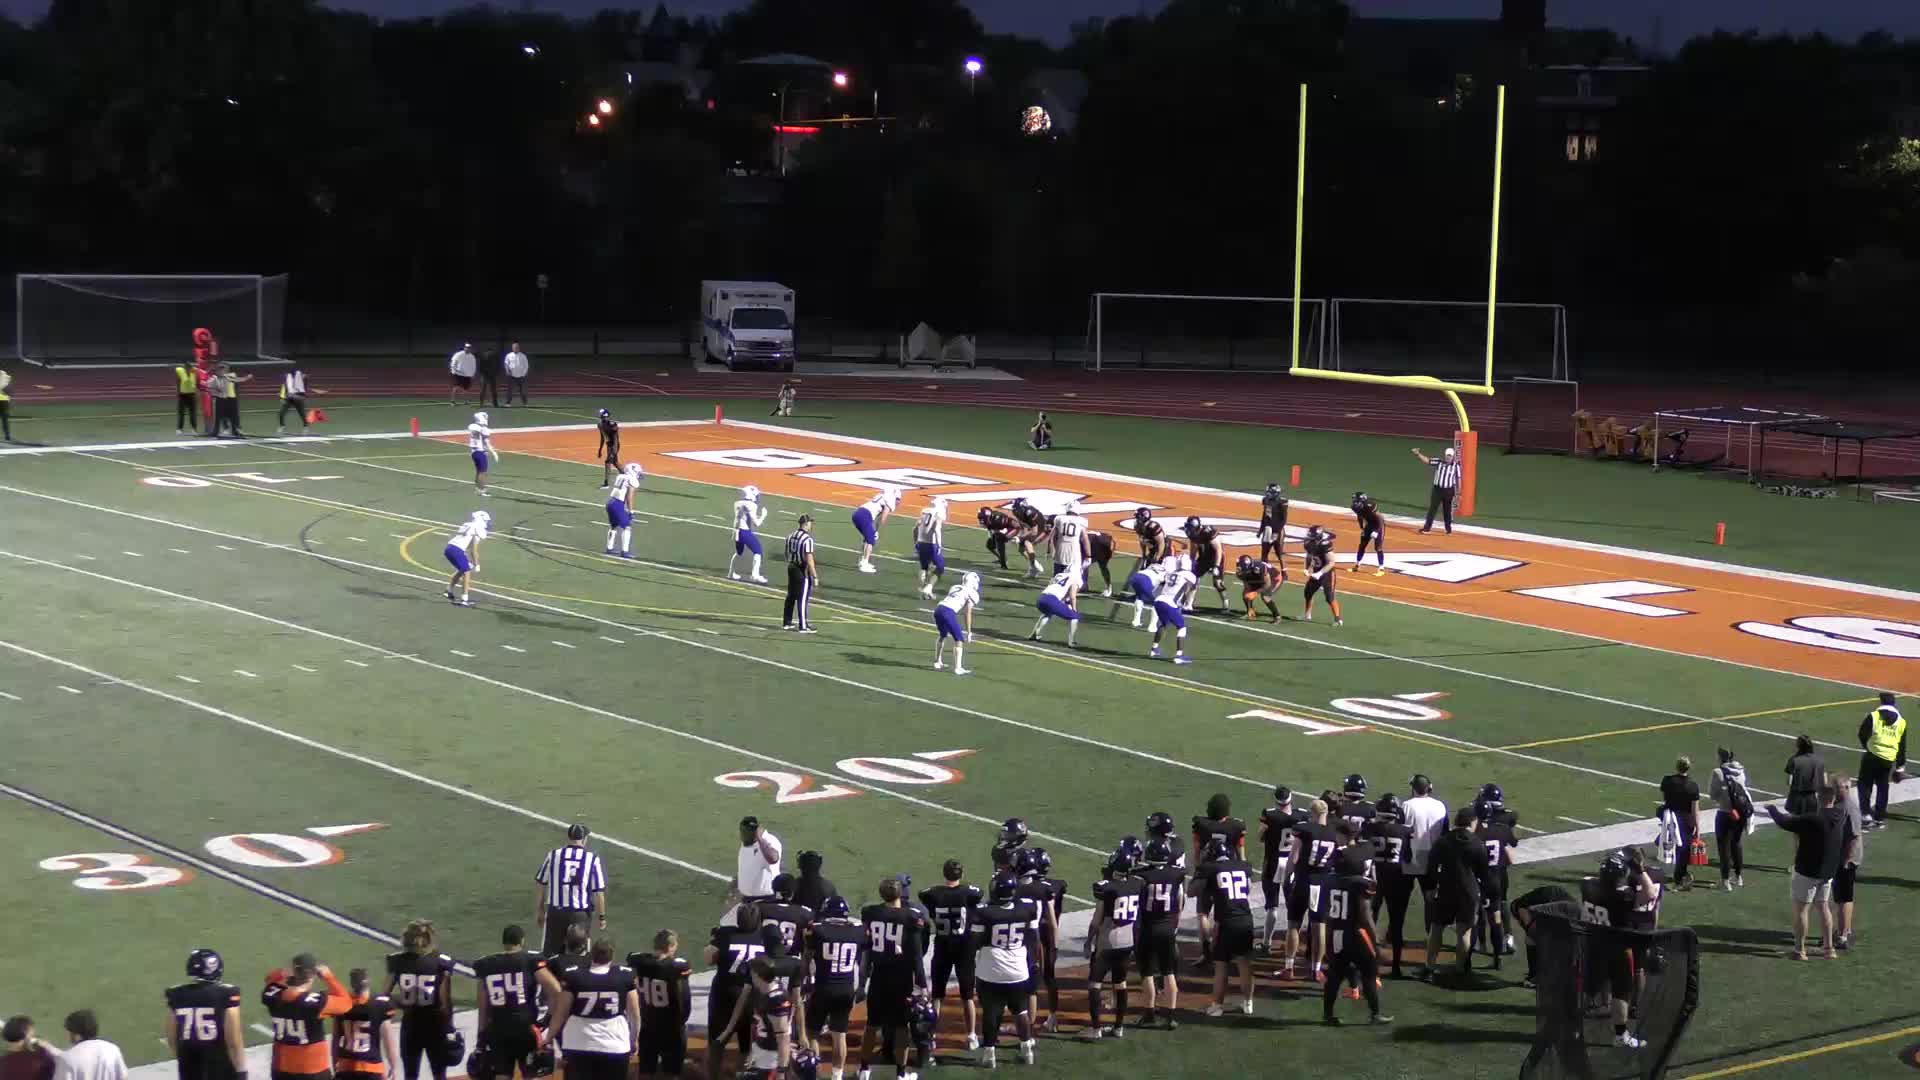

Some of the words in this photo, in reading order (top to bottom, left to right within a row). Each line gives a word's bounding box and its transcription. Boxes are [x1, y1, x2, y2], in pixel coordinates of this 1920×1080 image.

[1062, 522, 1077, 538] 10
[1226, 692, 1455, 736] 10
[713, 755, 965, 804] 20
[39, 831, 344, 891] 30
[1308, 839, 1336, 867] 17
[566, 859, 591, 884] F
[1216, 870, 1249, 900] 92
[1146, 883, 1173, 912] 14
[1329, 889, 1349, 920] 61
[935, 906, 967, 936] 53
[870, 920, 904, 954] 84
[822, 941, 858, 973] 40
[486, 971, 526, 1007] 64
[577, 991, 620, 1017] 73
[174, 1007, 218, 1042] 76
[270, 1017, 310, 1045] 74
[339, 1019, 371, 1053] 6
